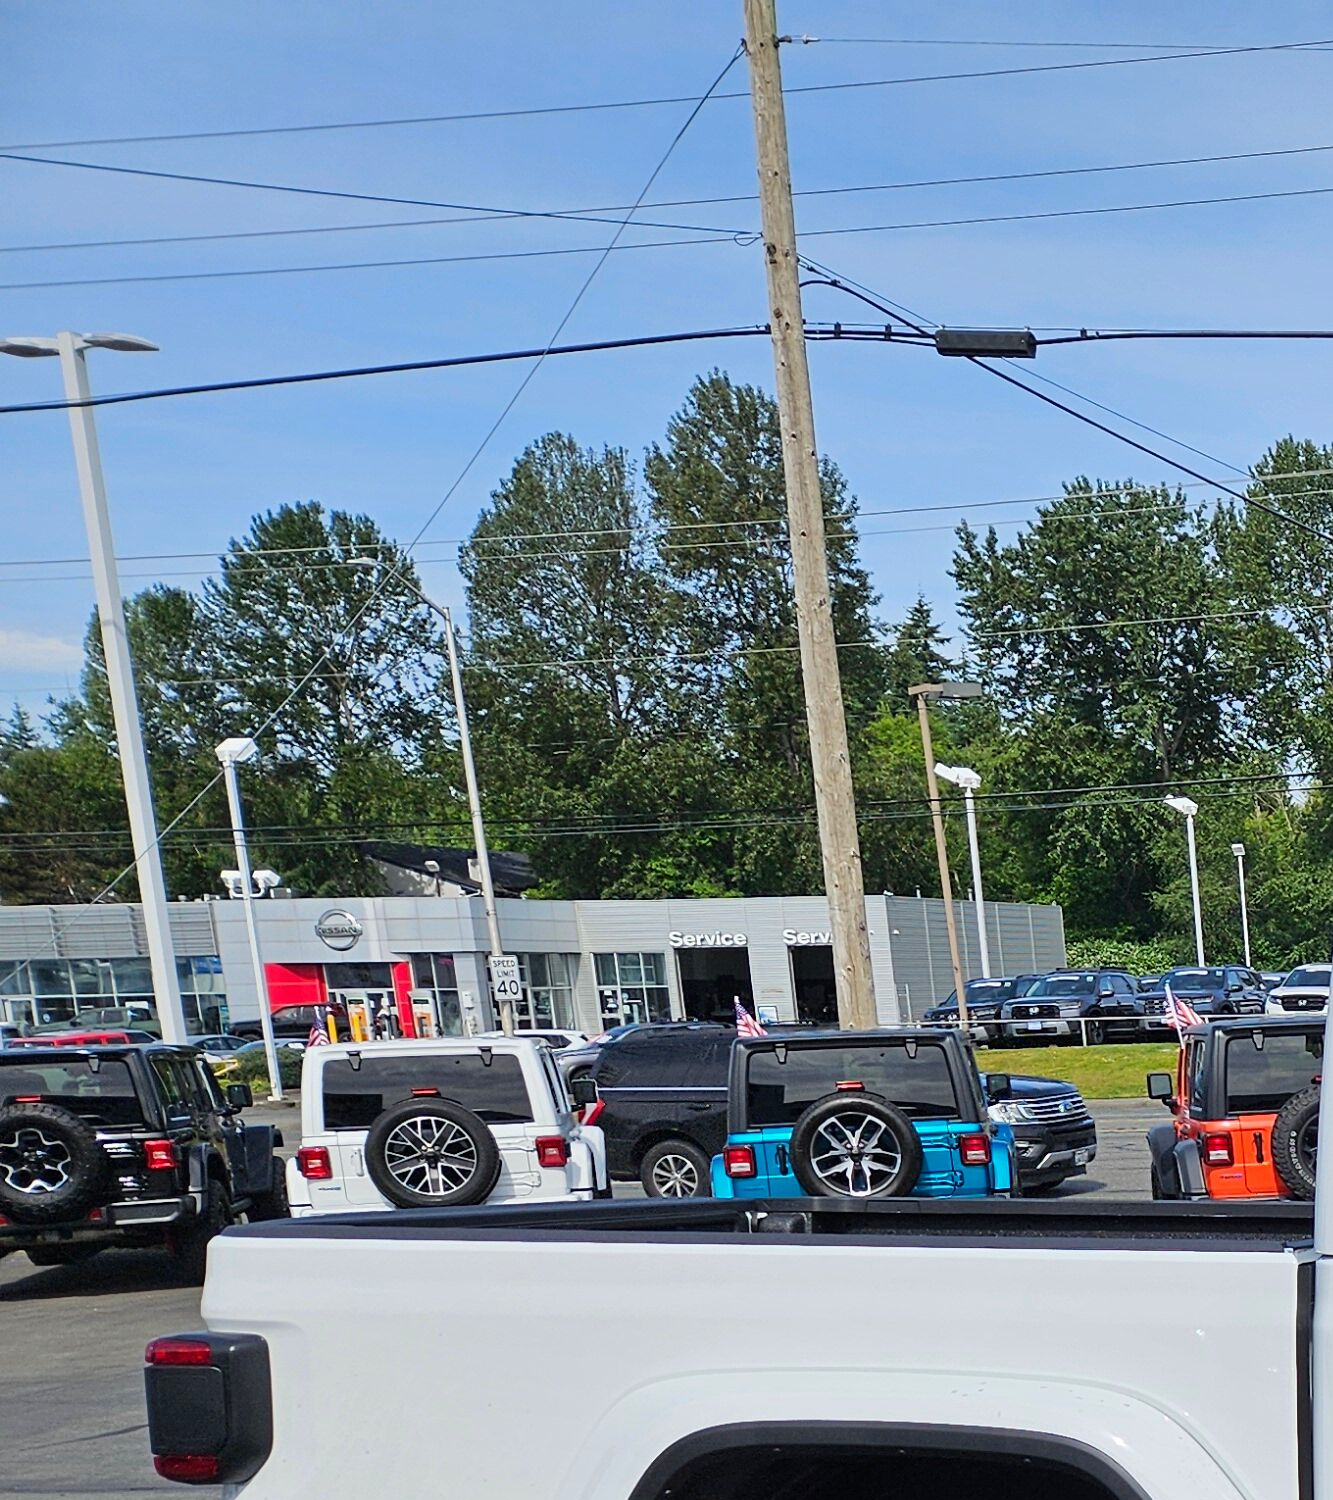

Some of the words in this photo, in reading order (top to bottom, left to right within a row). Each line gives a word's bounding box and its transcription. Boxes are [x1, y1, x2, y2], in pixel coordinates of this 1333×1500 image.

[669, 931, 747, 946] Service
[782, 928, 833, 944] Serv
[492, 960, 515, 968] SPEED
[497, 970, 515, 978] LIMIT
[496, 979, 519, 996] 40
